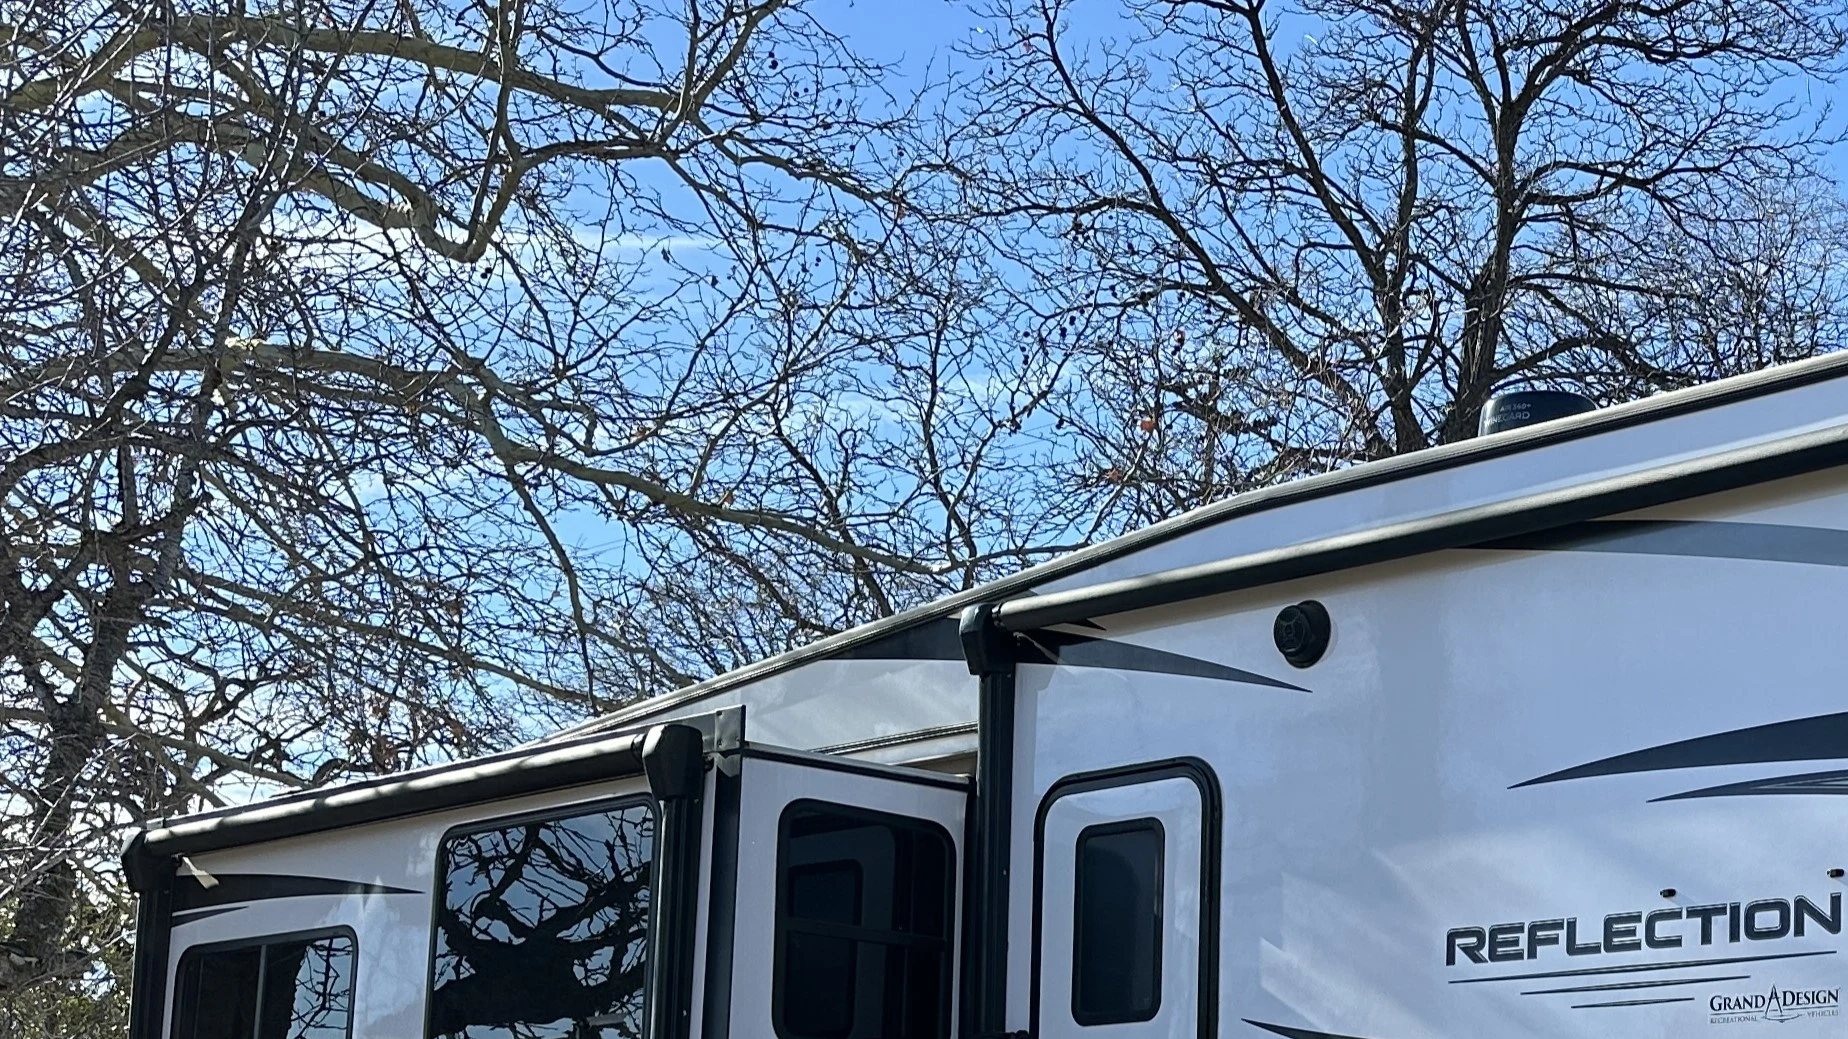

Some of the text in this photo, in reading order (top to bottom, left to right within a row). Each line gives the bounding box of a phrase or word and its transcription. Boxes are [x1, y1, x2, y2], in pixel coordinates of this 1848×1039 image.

[1484, 411, 1531, 426] WINEGARD
[1446, 892, 1842, 967] REFLECTION
[1709, 988, 1840, 1012] GRAND DESIGN
